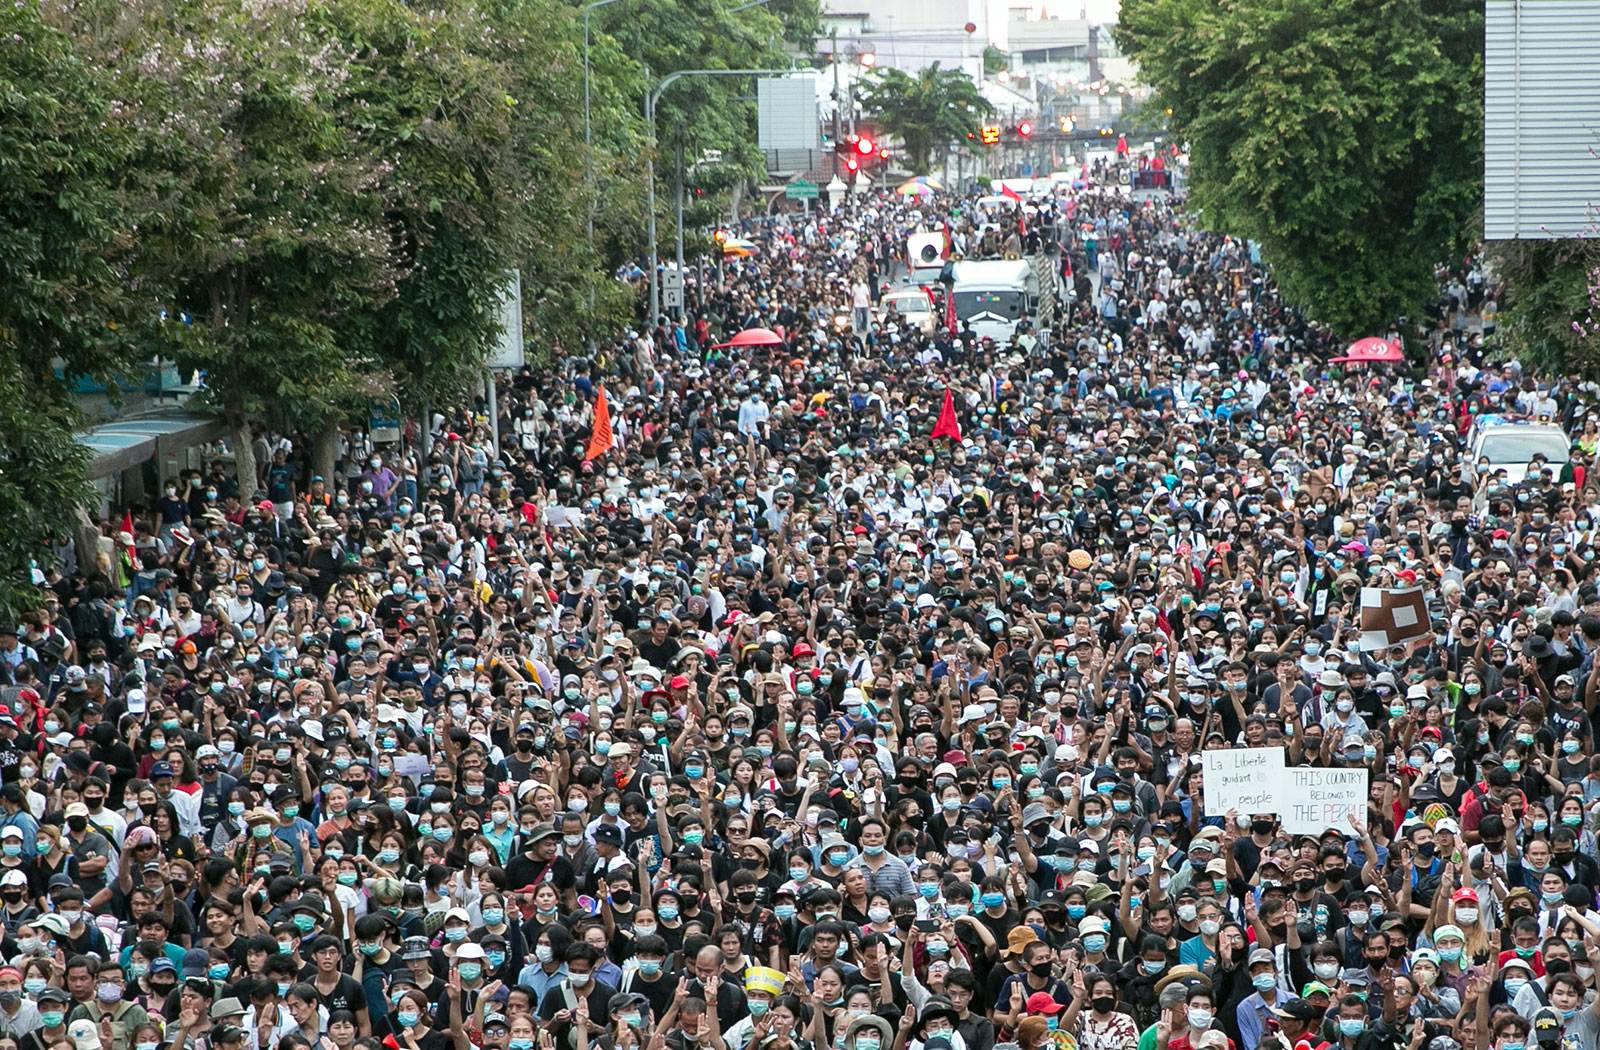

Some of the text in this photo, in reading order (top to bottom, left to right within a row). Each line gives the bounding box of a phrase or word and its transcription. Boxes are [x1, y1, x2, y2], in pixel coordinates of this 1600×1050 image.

[1210, 752, 1267, 771] La Liberté
[1221, 773, 1251, 786] guidant
[1292, 771, 1363, 787] THIS COUNTRY
[1217, 789, 1273, 808] le peuple
[1310, 790, 1356, 801] BELONGS TO
[1292, 804, 1320, 822] THE
